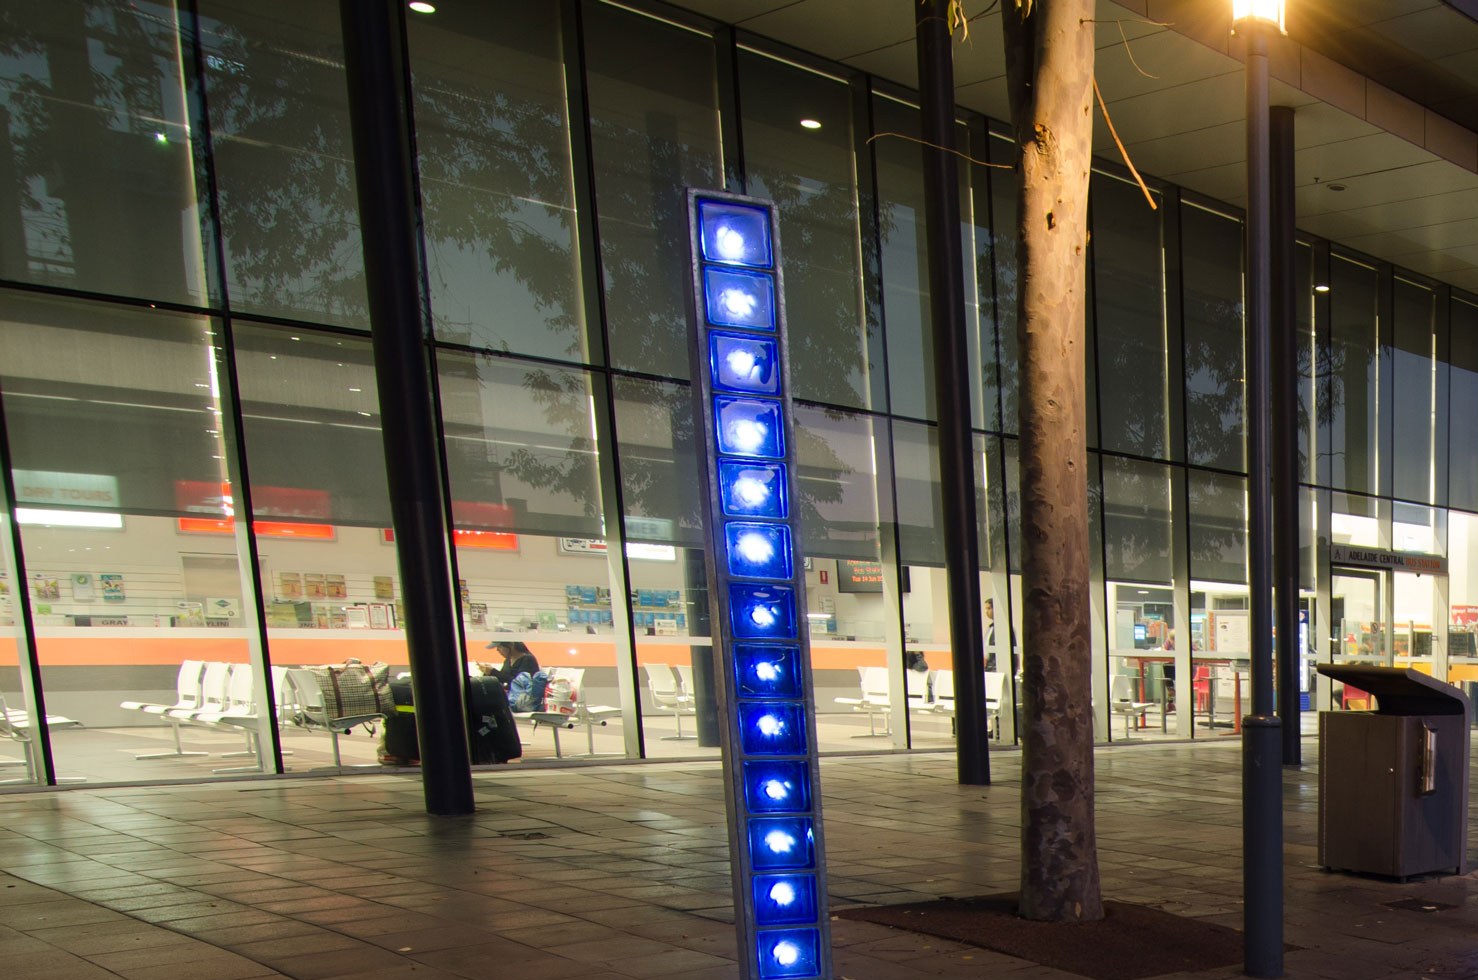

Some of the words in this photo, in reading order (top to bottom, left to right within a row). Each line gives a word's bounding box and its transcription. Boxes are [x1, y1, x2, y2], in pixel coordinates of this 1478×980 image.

[1349, 550, 1378, 562] ADELAIDE
[1380, 554, 1404, 566] CENTRAL
[1418, 558, 1440, 568] STATION
